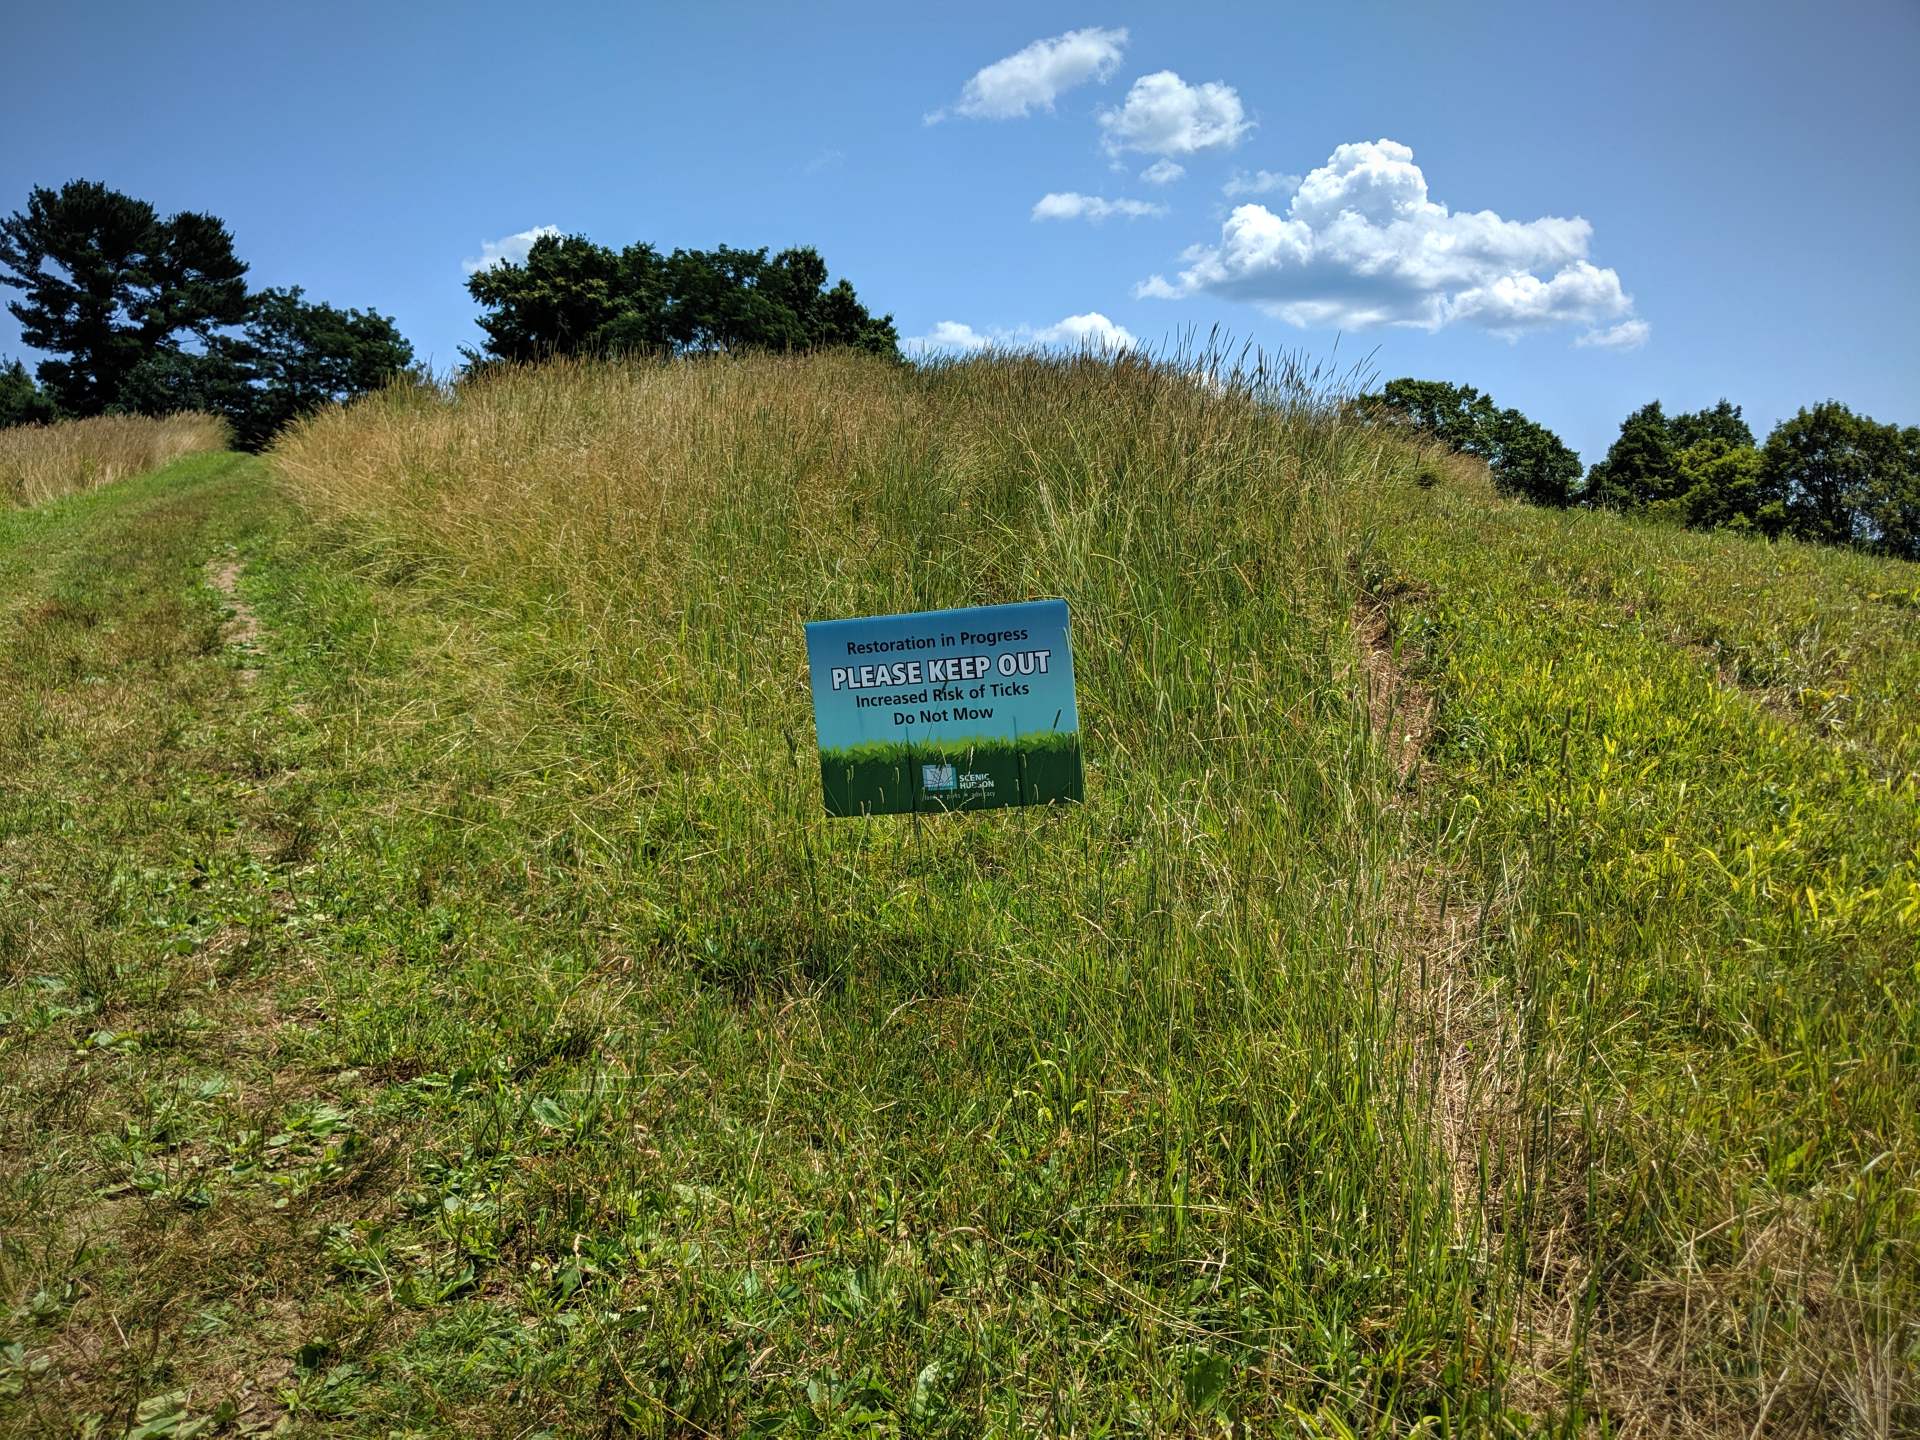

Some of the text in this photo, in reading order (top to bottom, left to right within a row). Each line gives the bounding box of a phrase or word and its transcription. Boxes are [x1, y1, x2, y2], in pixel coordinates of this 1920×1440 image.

[847, 629, 1028, 655] Restoration in Progress
[831, 649, 1051, 691] PLEASE KEEP OUT
[856, 681, 1030, 708] Increased Risk of Ticks
[893, 707, 994, 725] Do Not Mow
[959, 773, 990, 782] SCENIC
